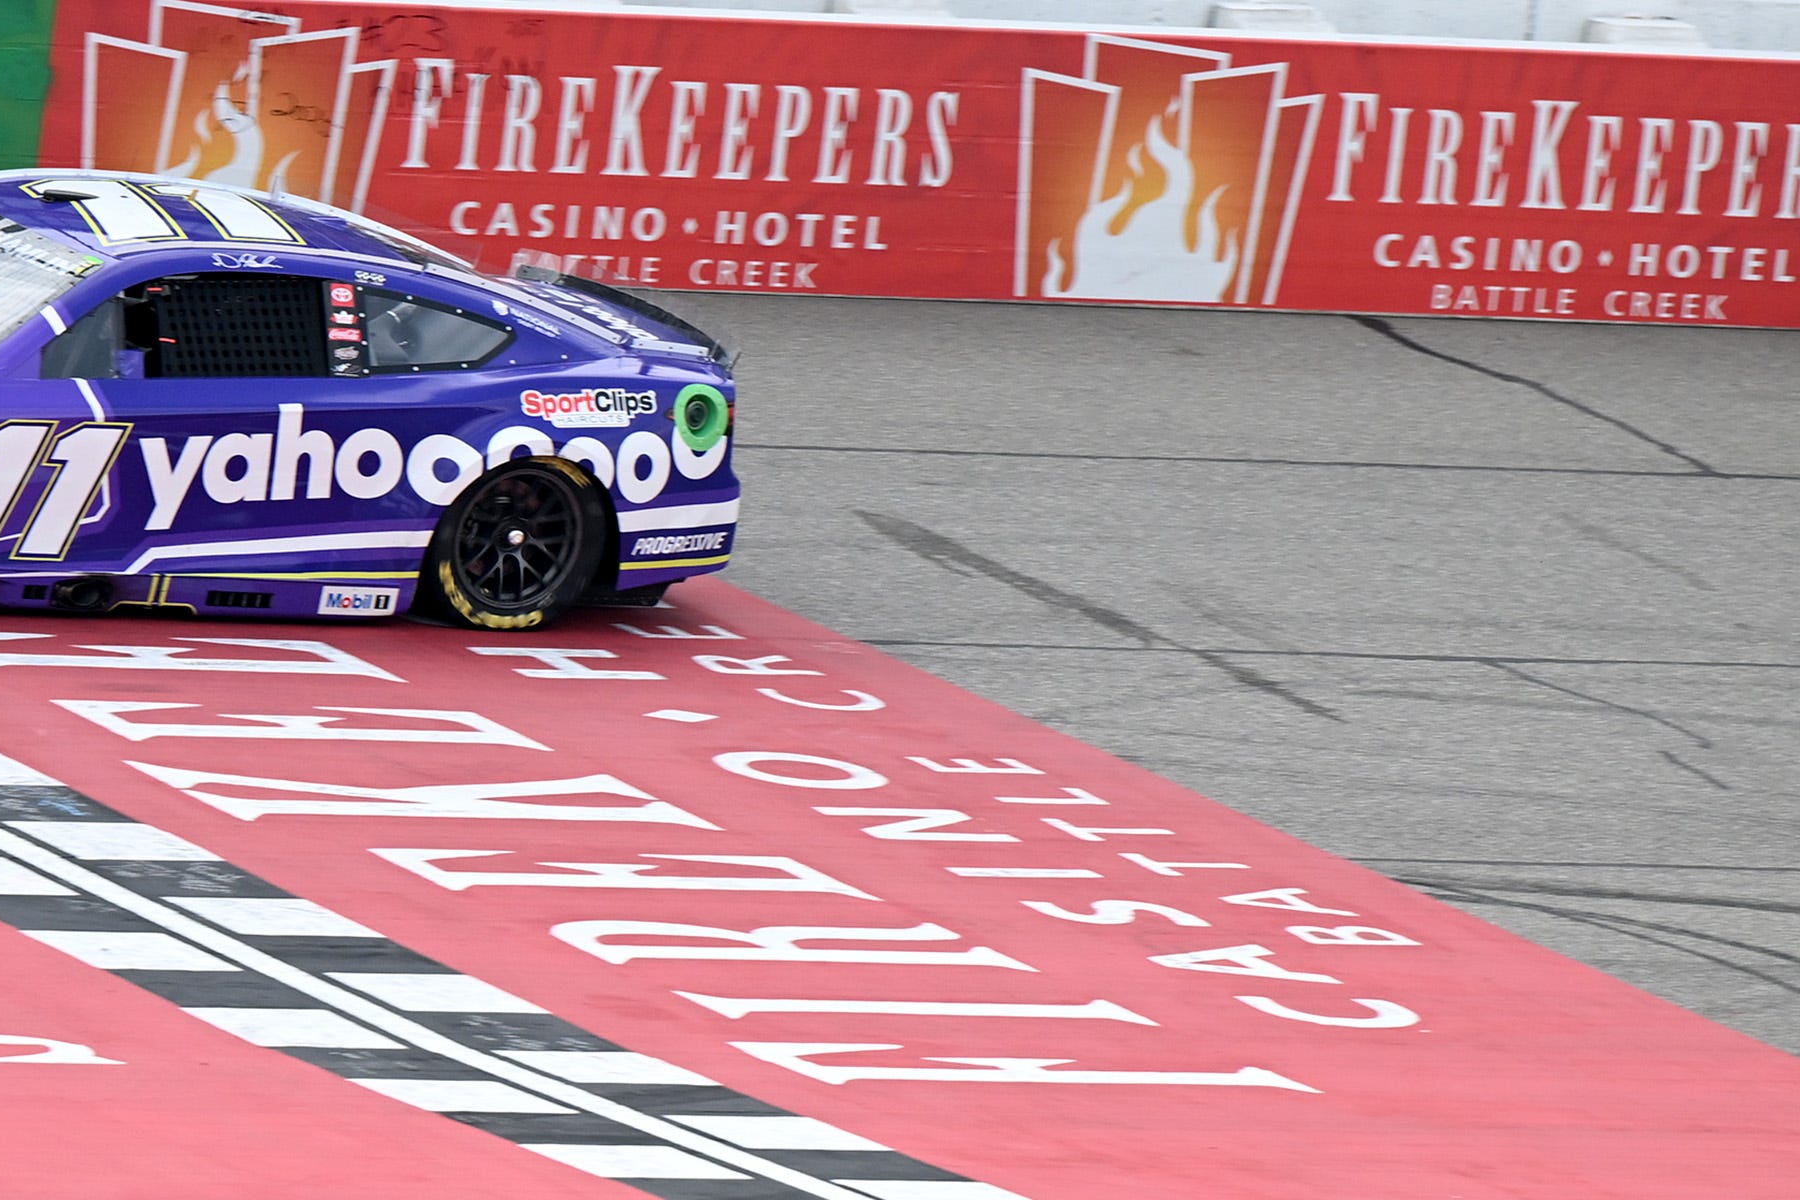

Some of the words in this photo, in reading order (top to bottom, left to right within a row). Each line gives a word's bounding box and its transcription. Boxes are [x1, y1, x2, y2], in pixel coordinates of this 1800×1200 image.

[400, 57, 960, 187] FIREKEEPERS
[18, 178, 307, 247] 11
[450, 201, 667, 241] CASINO
[713, 211, 889, 250] HOTEL
[688, 258, 819, 288] CREEK
[1373, 233, 1583, 273] CASINO
[1627, 243, 1796, 282] HOTEL
[1429, 284, 1578, 314] BATTLE
[1603, 289, 1729, 319] CREEK
[523, 391, 654, 418] SportClips
[631, 532, 728, 556] PROGRESSIVE
[326, 593, 372, 609] Mobil
[374, 595, 390, 609] 1
[905, 755, 1422, 947] BATTLE
[711, 750, 1421, 1029] CASINO
